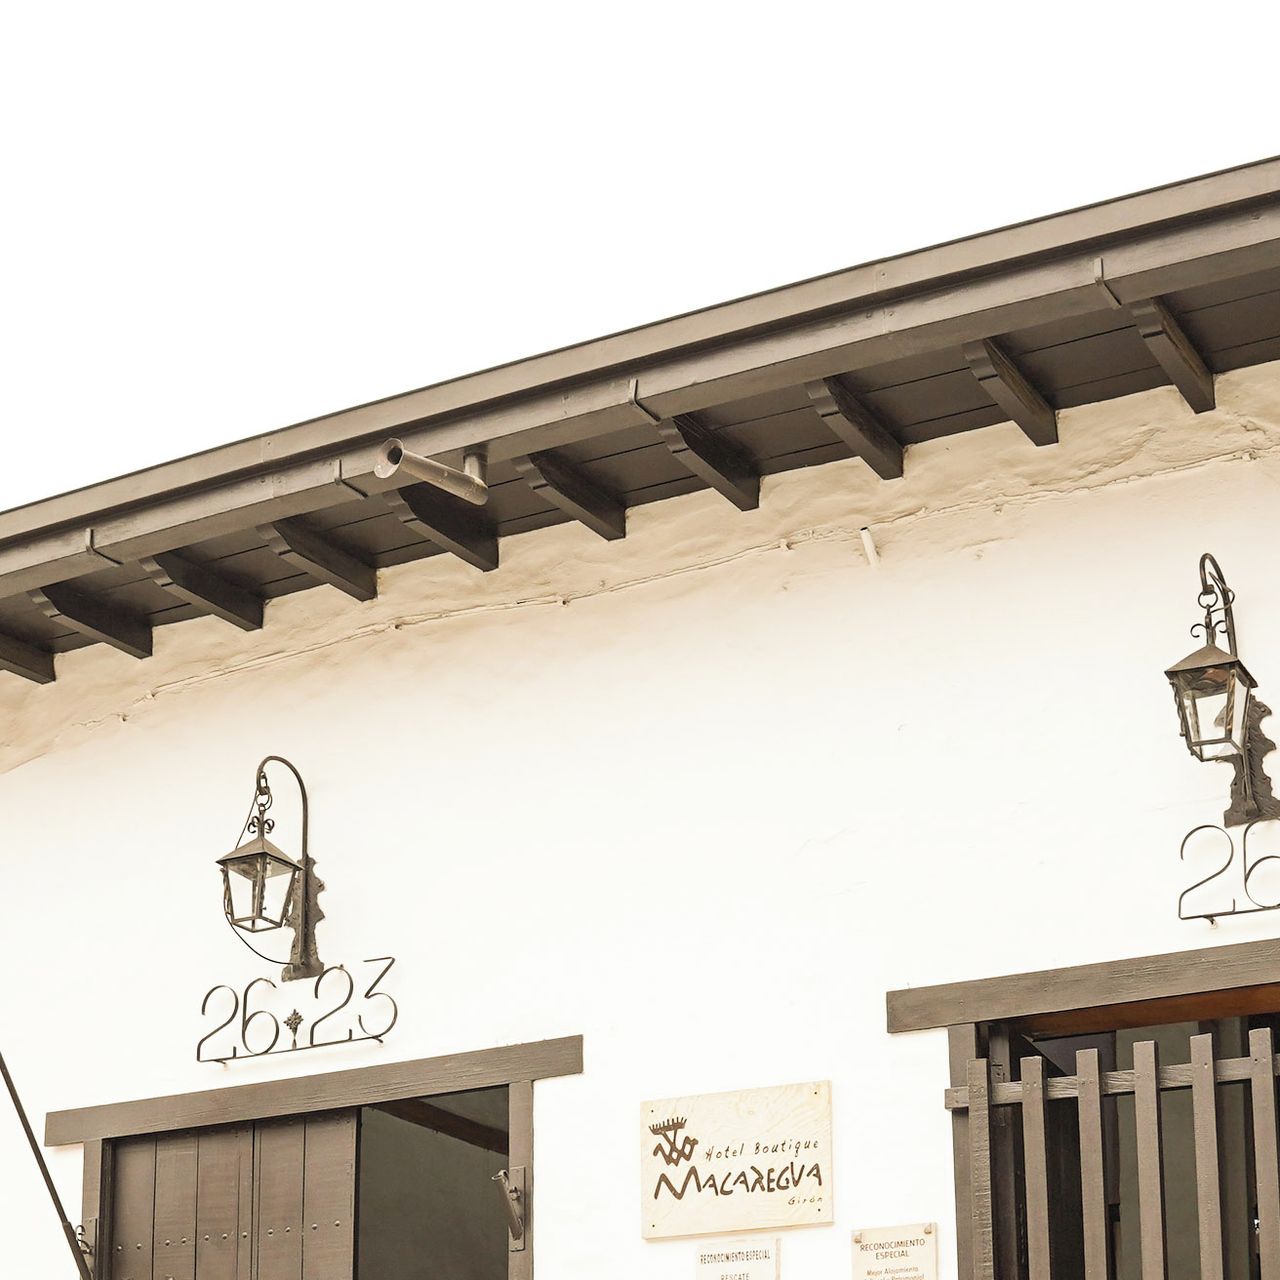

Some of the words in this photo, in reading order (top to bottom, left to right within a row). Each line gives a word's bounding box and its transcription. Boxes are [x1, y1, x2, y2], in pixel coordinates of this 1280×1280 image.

[705, 1143, 745, 1162] Hotel
[754, 1138, 819, 1158] Boutique
[859, 1238, 926, 1252] RECONOCIMIENTO
[875, 1249, 910, 1260] ESPECIAL
